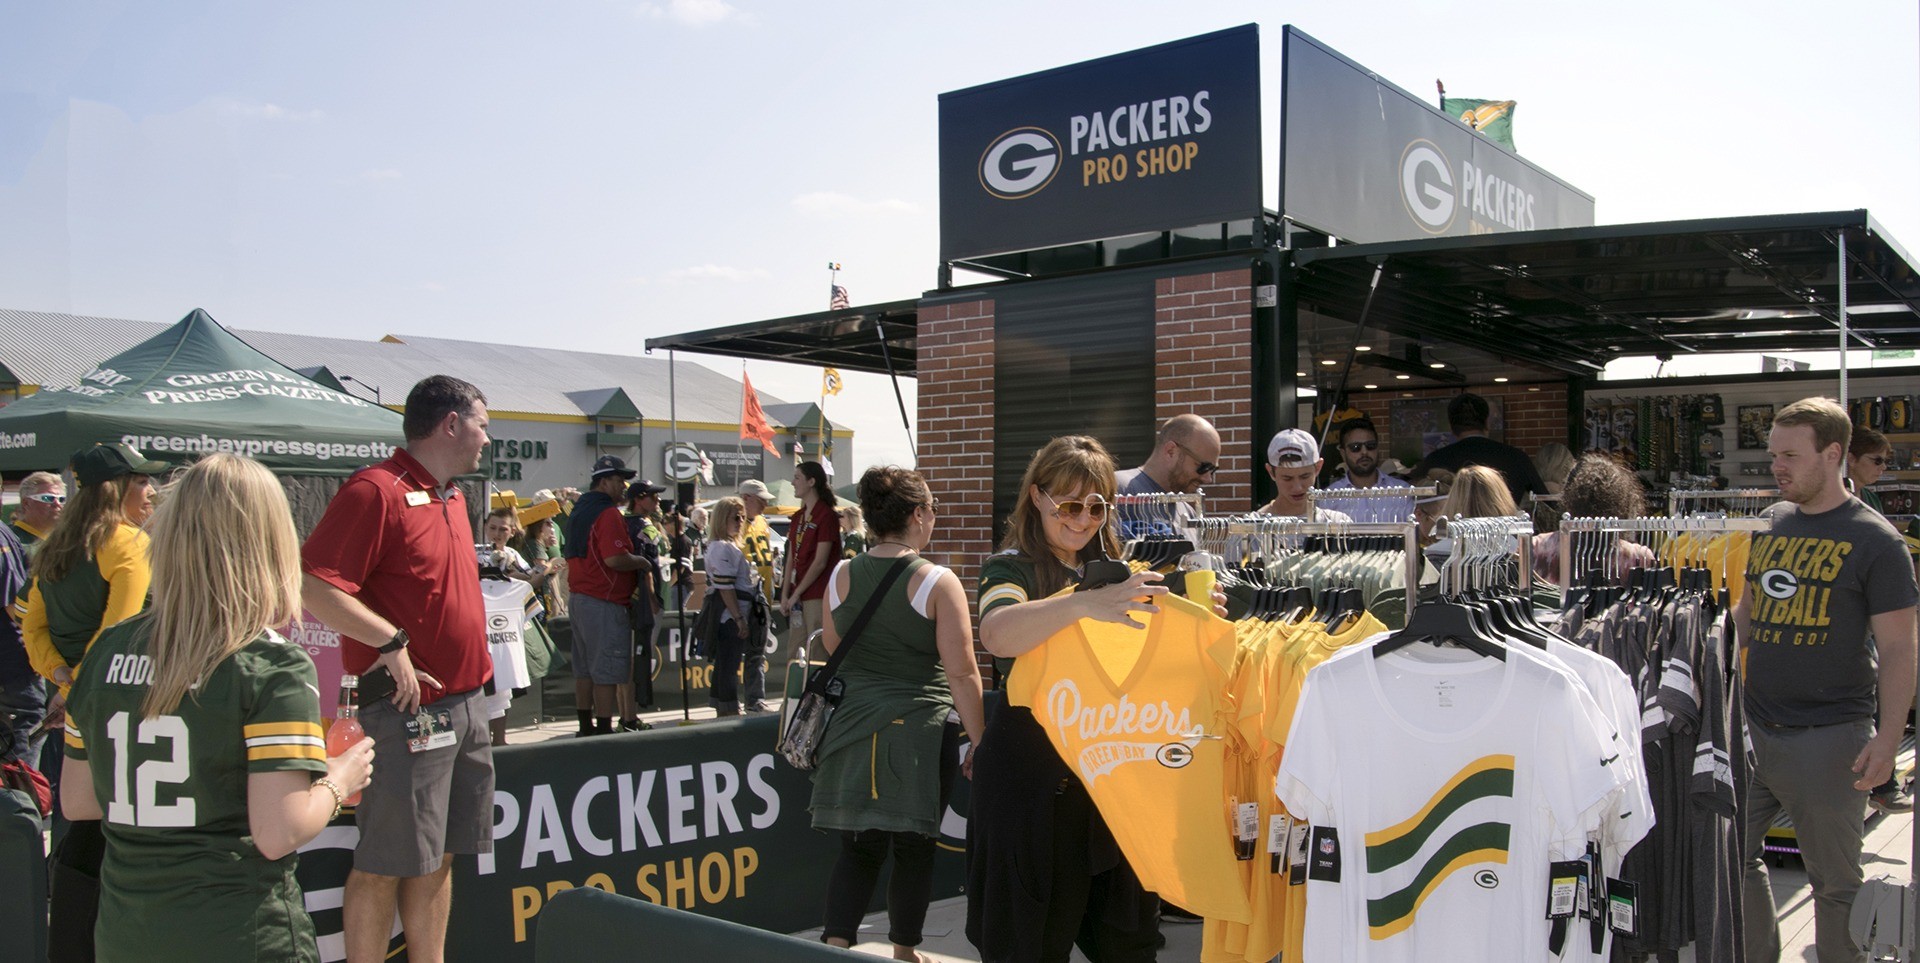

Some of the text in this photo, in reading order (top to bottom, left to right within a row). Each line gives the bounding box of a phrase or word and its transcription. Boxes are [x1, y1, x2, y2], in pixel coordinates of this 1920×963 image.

[1070, 90, 1212, 155] PACKERS
[1083, 141, 1199, 187] PRO SHOP
[1462, 160, 1535, 231] PACKERS
[142, 382, 369, 408] PRESS-GAZETTE
[166, 369, 271, 388] GREEN
[1794, 632, 1828, 646] GO!
[1048, 678, 1199, 749] Packers
[107, 711, 196, 827] 12
[1083, 745, 1146, 774] GREEN BAY
[477, 753, 781, 876] PACKERS
[636, 846, 759, 910] SHOP
